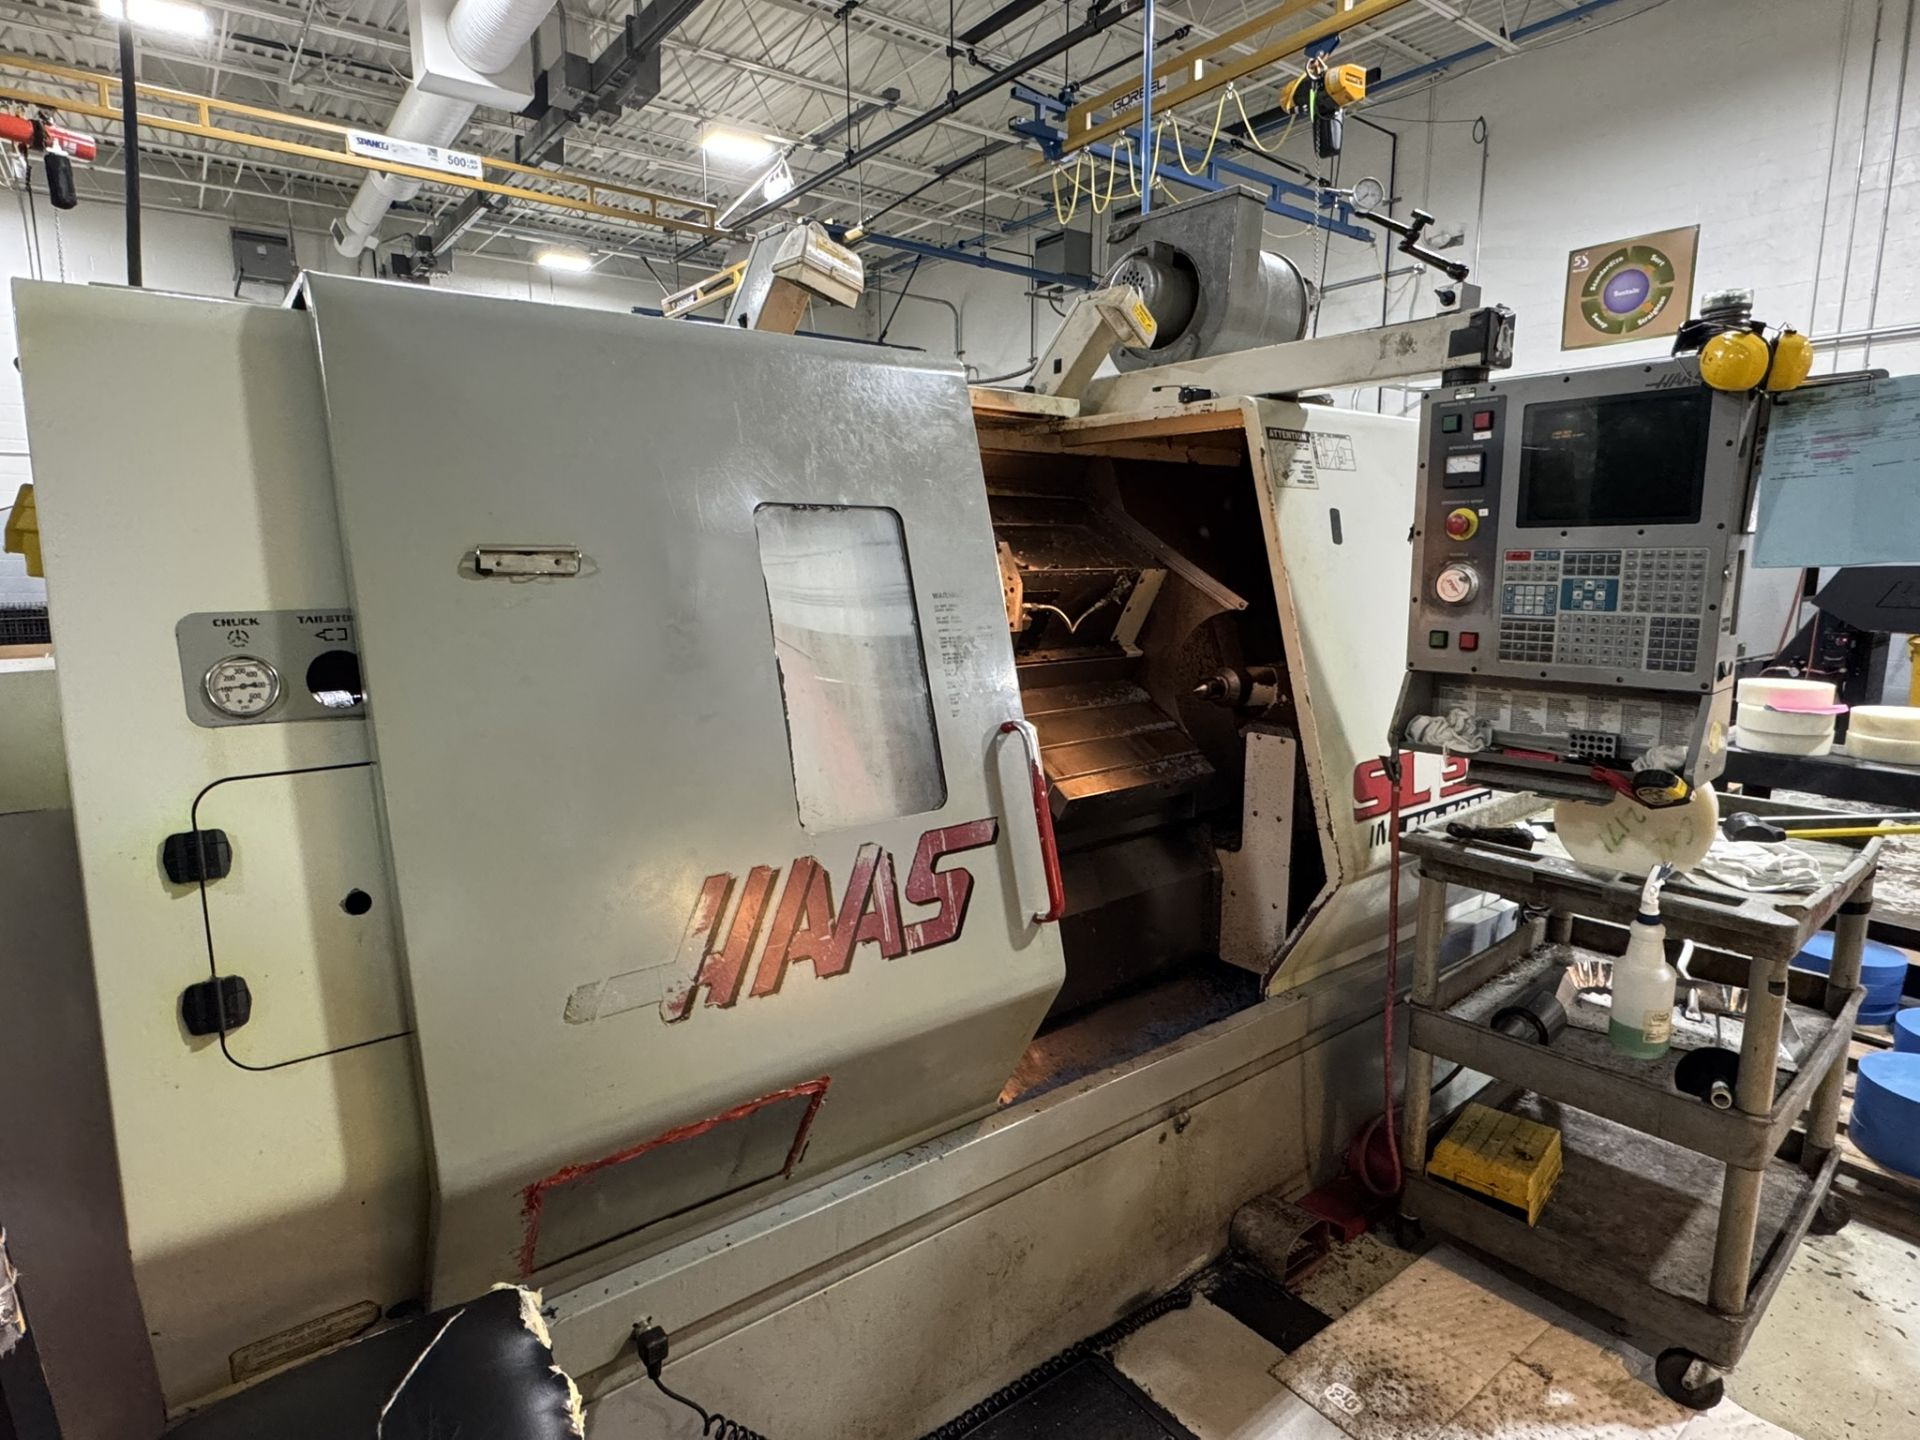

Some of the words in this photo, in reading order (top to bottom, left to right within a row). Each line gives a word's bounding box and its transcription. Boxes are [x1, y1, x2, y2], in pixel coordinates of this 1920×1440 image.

[447, 154, 467, 168] 500
[1268, 429, 1308, 441] ATTENTION
[212, 617, 260, 627] CHUCK
[659, 816, 1000, 1024] HAAS
